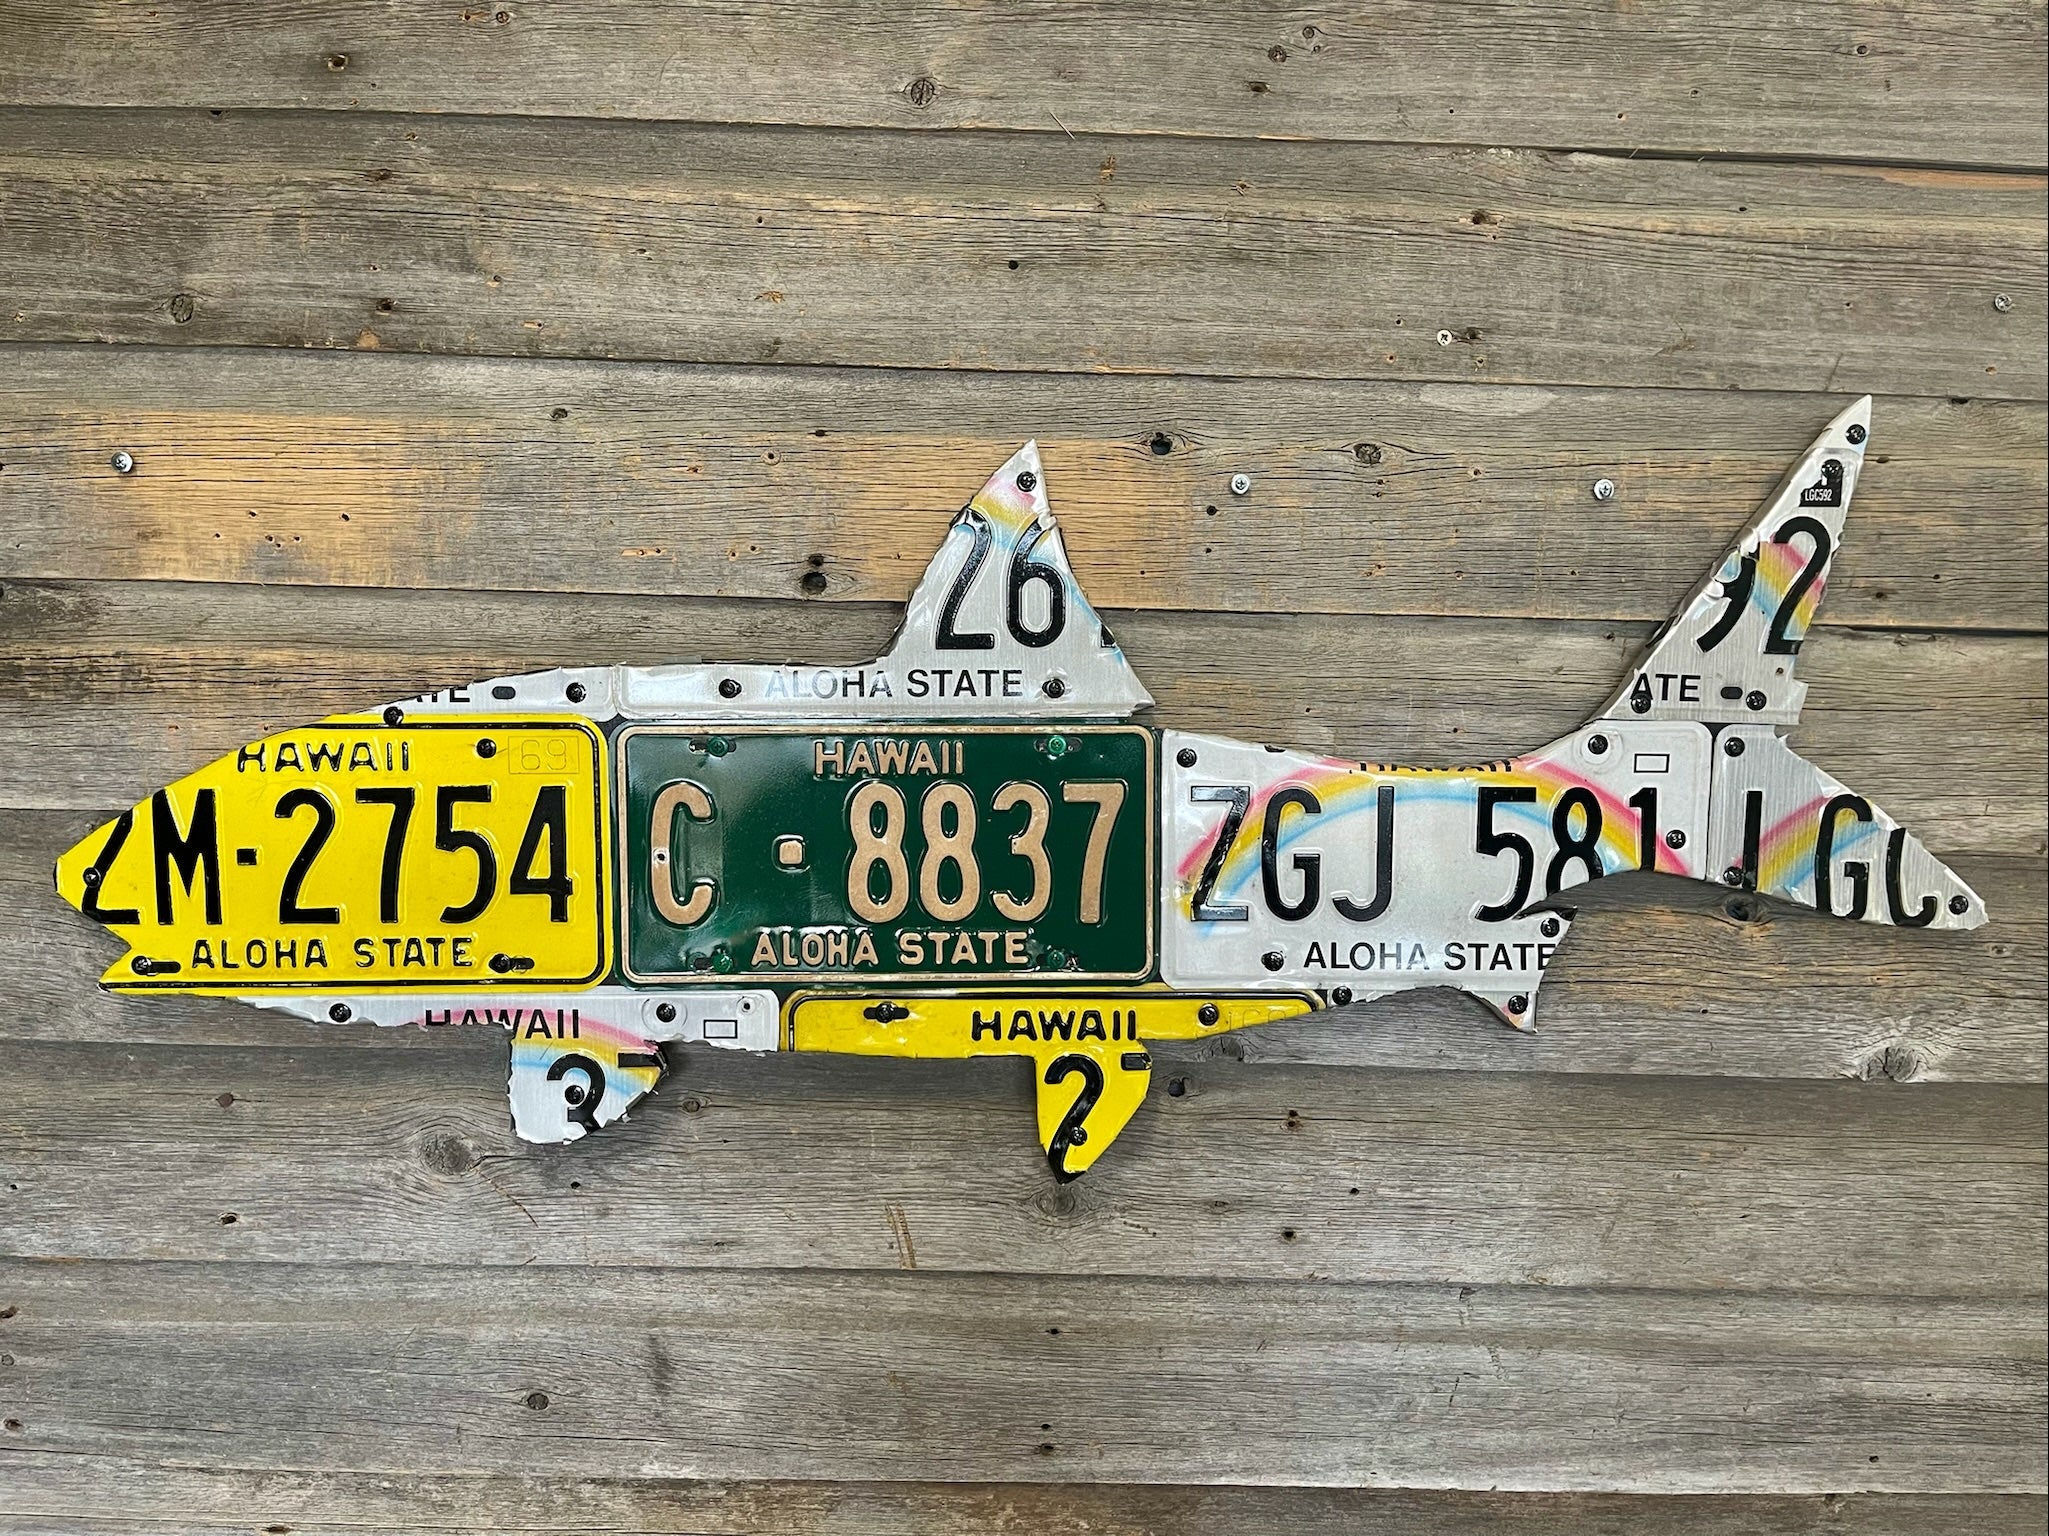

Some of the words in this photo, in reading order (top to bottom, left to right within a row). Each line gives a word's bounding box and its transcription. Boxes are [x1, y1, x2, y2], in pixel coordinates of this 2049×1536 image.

[1804, 488, 1833, 502] LGC592
[935, 510, 1116, 649] 26
[765, 669, 893, 699] ALOHA
[907, 668, 1023, 697] STATE
[237, 742, 411, 773] HAWAII
[813, 740, 965, 776] HAWAII
[846, 780, 1127, 925] 8837
[1189, 785, 1396, 922] ZGJ
[1476, 786, 1658, 923] 581
[192, 937, 328, 969] ALOHA
[353, 937, 473, 967] STATE
[751, 931, 879, 968] ALOHA
[898, 930, 1030, 966] STATE
[1303, 942, 1427, 971] ALOHA
[971, 1009, 1138, 1042] HAWAII
